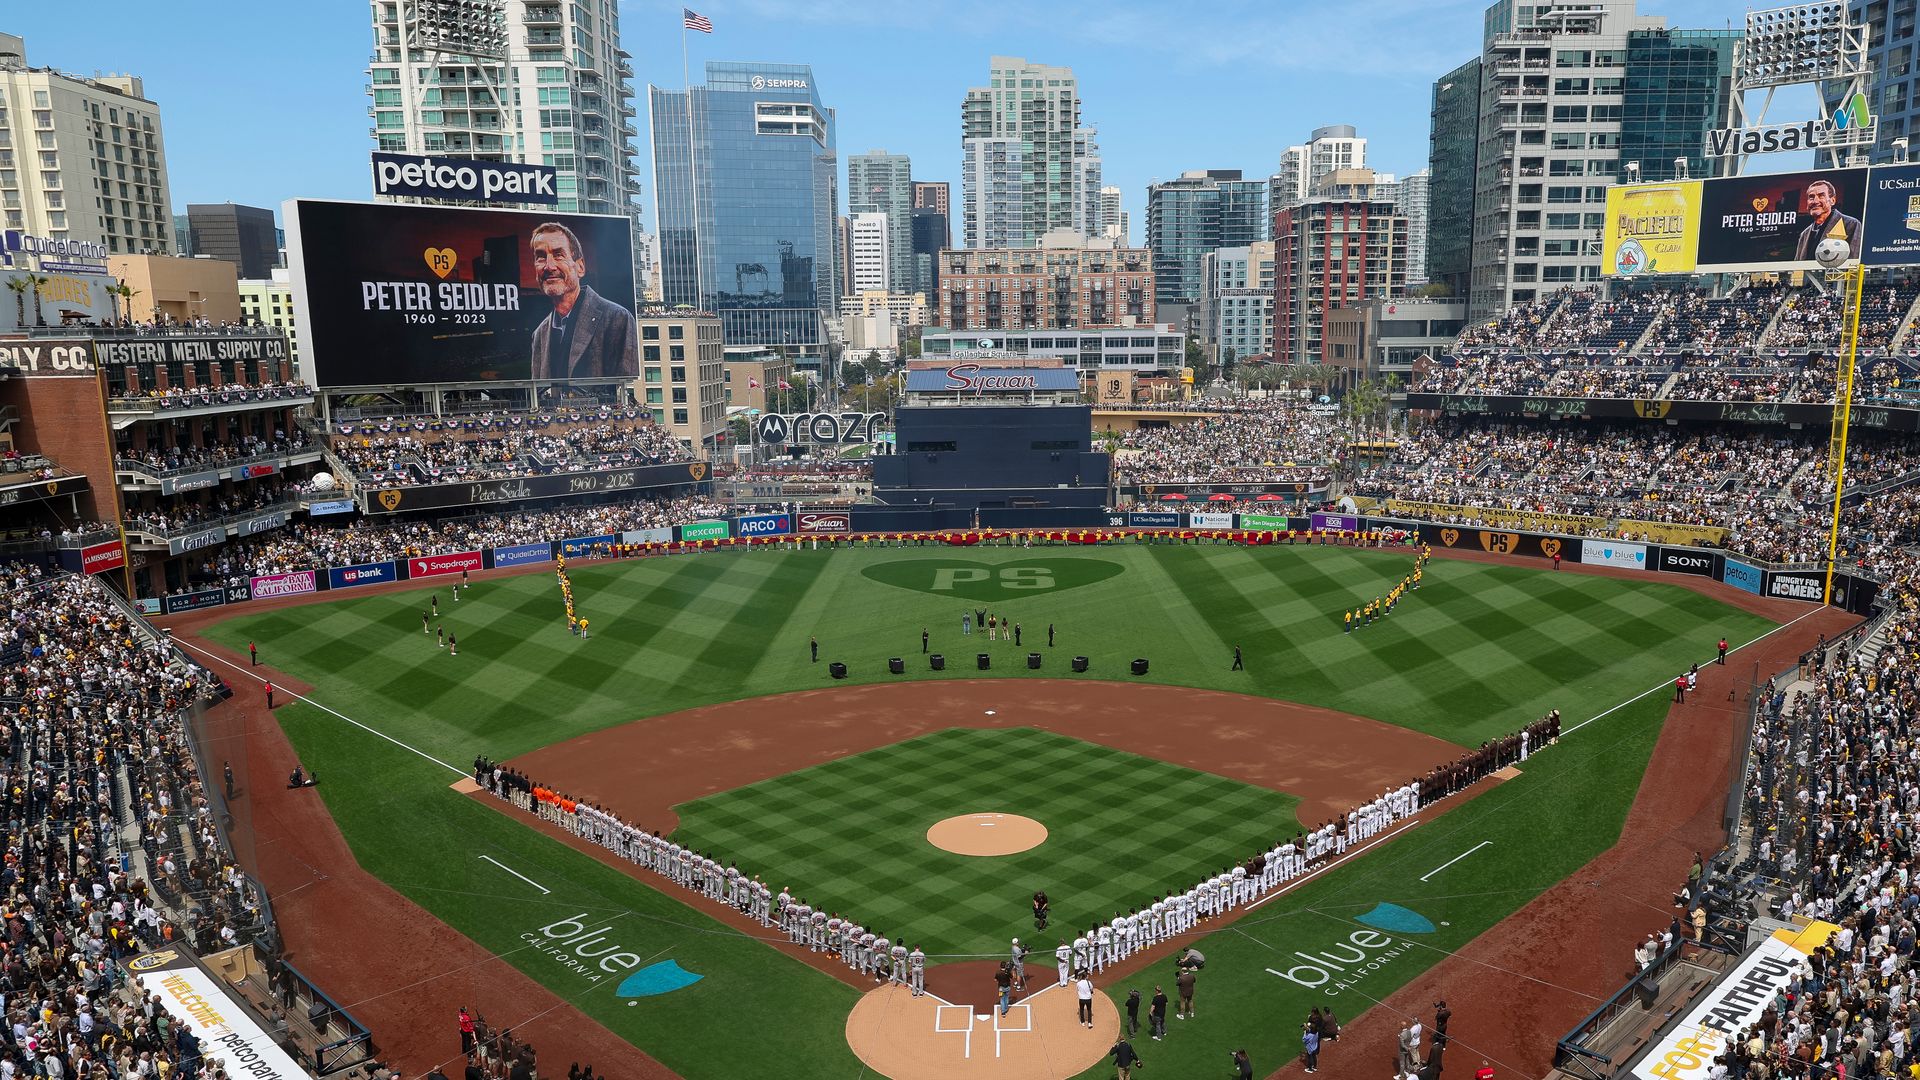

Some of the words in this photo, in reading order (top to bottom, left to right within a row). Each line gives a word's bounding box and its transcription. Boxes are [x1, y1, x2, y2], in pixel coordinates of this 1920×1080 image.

[767, 79, 807, 88] SEMPRA
[1710, 120, 1821, 156] Viasat
[378, 158, 478, 193] petco
[483, 167, 555, 199] park
[1879, 180, 1895, 190] UC
[1895, 179, 1914, 189] San
[1721, 214, 1753, 228] PETER
[1756, 211, 1797, 226] SEIDLER
[24, 236, 107, 259] QuidelOrtho
[433, 255, 449, 269] PS
[361, 281, 432, 311] PETER
[439, 283, 520, 311] SEIDLER
[404, 313, 435, 324] 1960
[454, 313, 486, 324] 2023
[51, 346, 95, 371] CO.
[96, 343, 166, 364] WESTERN
[171, 342, 215, 362] METAL
[217, 341, 262, 360] SUPPLY
[266, 341, 285, 358] CO.
[954, 350, 989, 358] Gallagher
[991, 350, 1017, 358] Square
[945, 362, 1039, 397] Sycuan
[1111, 380, 1119, 390] 19
[1523, 401, 1547, 413] 1960
[1557, 401, 1586, 414] 2023
[1643, 401, 1660, 417] PS
[1720, 404, 1747, 420] Peter
[1749, 404, 1785, 421] Seidler
[1866, 411, 1888, 426] 2023
[792, 413, 886, 443] razr
[693, 466, 702, 478] PS
[569, 476, 596, 492] 1960
[606, 473, 635, 488] 2023
[470, 484, 496, 501] Peter
[498, 480, 531, 499] Seidler
[385, 494, 396, 505] PS
[1395, 501, 1434, 510] CHROME
[1436, 504, 1464, 512] TOUR
[801, 514, 844, 531] Sycuan
[1109, 517, 1123, 526] 396
[1477, 508, 1495, 516] THE
[1495, 509, 1516, 518] NEW
[1516, 512, 1541, 520] GOLD
[1543, 514, 1594, 524] STANDARD
[687, 526, 724, 537] dexcom
[741, 520, 776, 533] ARCO
[1445, 533, 1454, 542] PS
[1489, 533, 1508, 552] PS
[507, 548, 549, 560] QuidelOrtho
[1545, 542, 1555, 551] PS
[1584, 547, 1603, 556] blue
[1614, 550, 1635, 560] blue
[132, 552, 146, 567] 336
[430, 557, 478, 570] Snapdragon
[1667, 555, 1710, 568] SONY
[288, 573, 311, 584] BAJA
[344, 571, 357, 580] us
[358, 567, 382, 578] bank
[932, 567, 1056, 590] PS
[1726, 566, 1747, 581] petco
[1775, 575, 1804, 585] HUNGRY
[1804, 577, 1820, 587] FOR
[229, 587, 248, 601] 342
[254, 581, 315, 597] CALIFORNIA
[538, 913, 641, 973] blue
[520, 932, 602, 983] CALIFORNIA
[1265, 930, 1391, 989] blue
[1324, 941, 1415, 996] CALIFORNIA
[160, 974, 225, 1029] WELCOME
[1698, 956, 1799, 1034] FAITHFUL
[213, 1032, 259, 1063] petco
[1649, 1037, 1717, 1080] FOR
